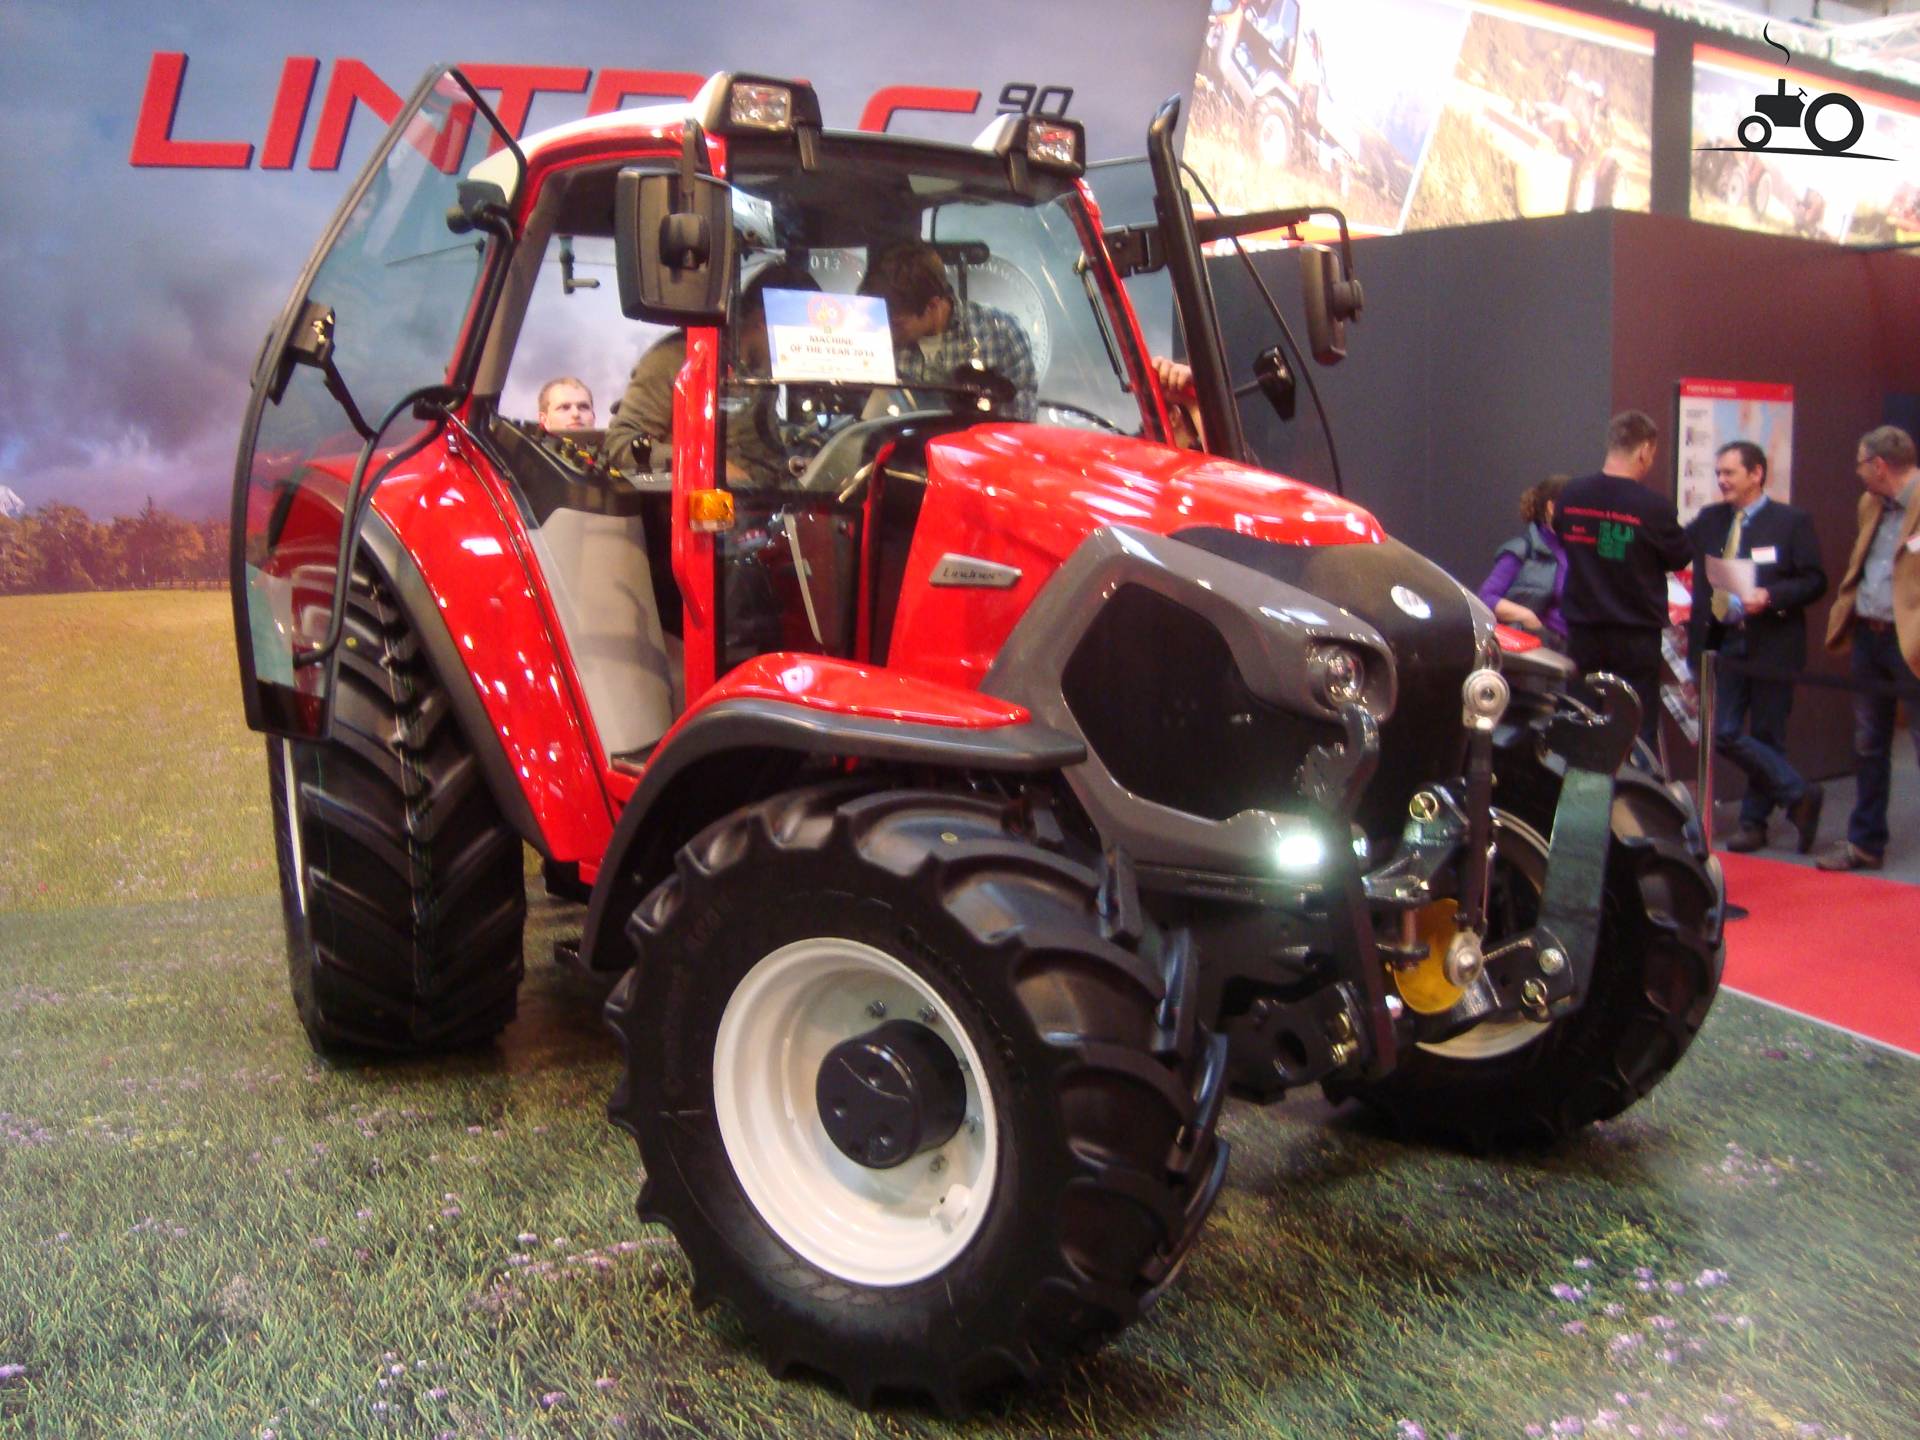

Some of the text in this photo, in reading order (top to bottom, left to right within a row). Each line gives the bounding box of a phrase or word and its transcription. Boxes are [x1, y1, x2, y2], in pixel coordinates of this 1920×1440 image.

[129, 51, 1073, 175] LINT 90
[809, 335, 853, 345] MACHINE
[790, 344, 801, 352] OF
[826, 348, 850, 356] YEAR
